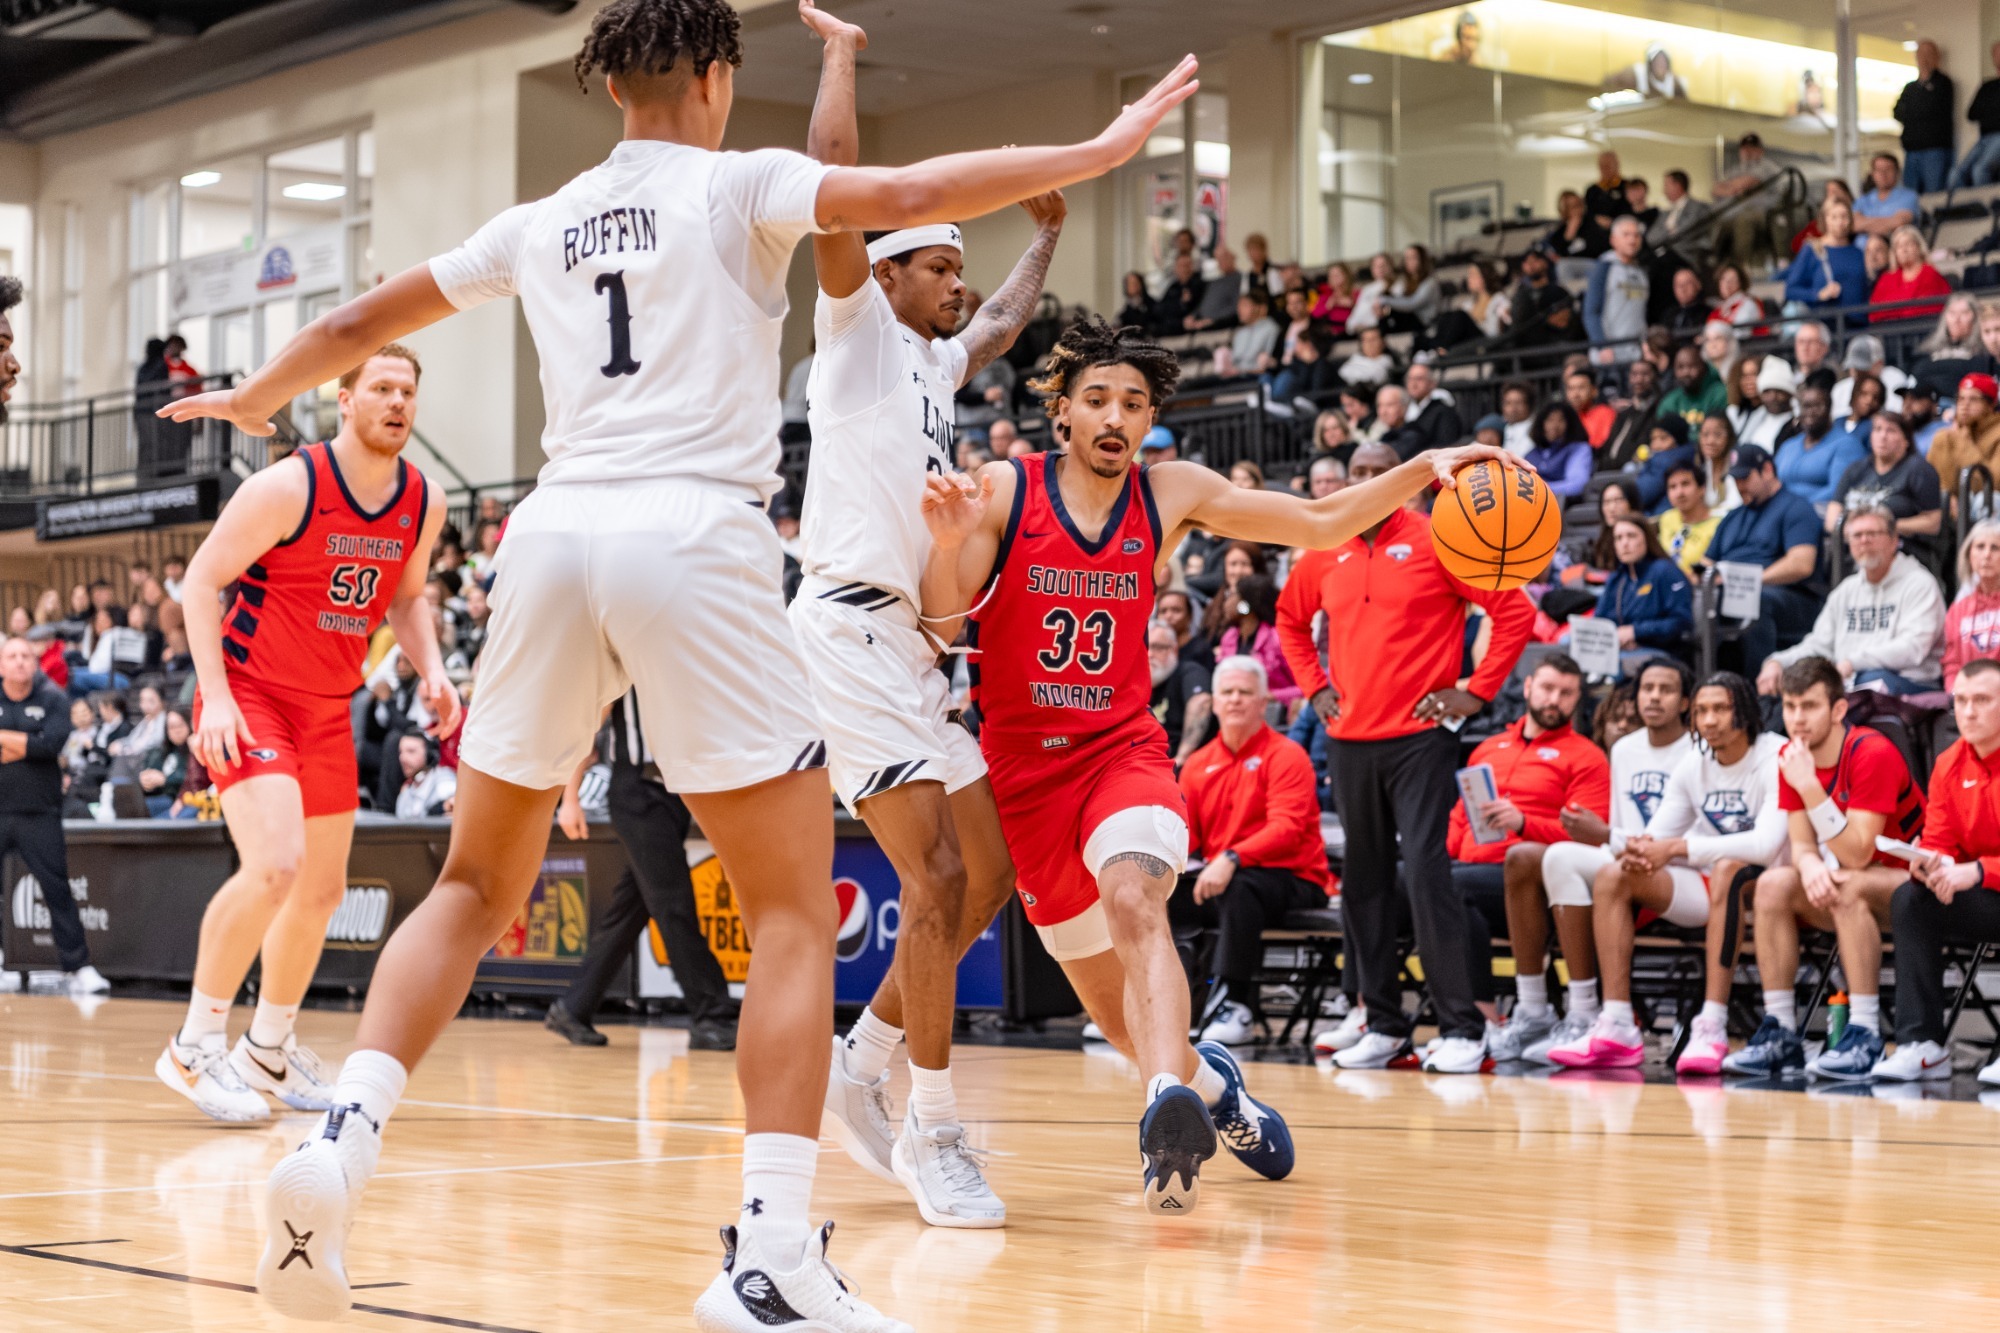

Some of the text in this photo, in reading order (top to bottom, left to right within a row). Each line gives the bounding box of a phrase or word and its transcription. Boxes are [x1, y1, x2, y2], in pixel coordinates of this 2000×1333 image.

[564, 208, 656, 273] RUFFIN
[594, 269, 642, 378] 1
[327, 563, 381, 609] 50
[1027, 564, 1139, 600] SOUTHERN
[1036, 606, 1117, 675] 33
[1028, 681, 1115, 711] INDIANA
[1042, 736, 1070, 750] USI
